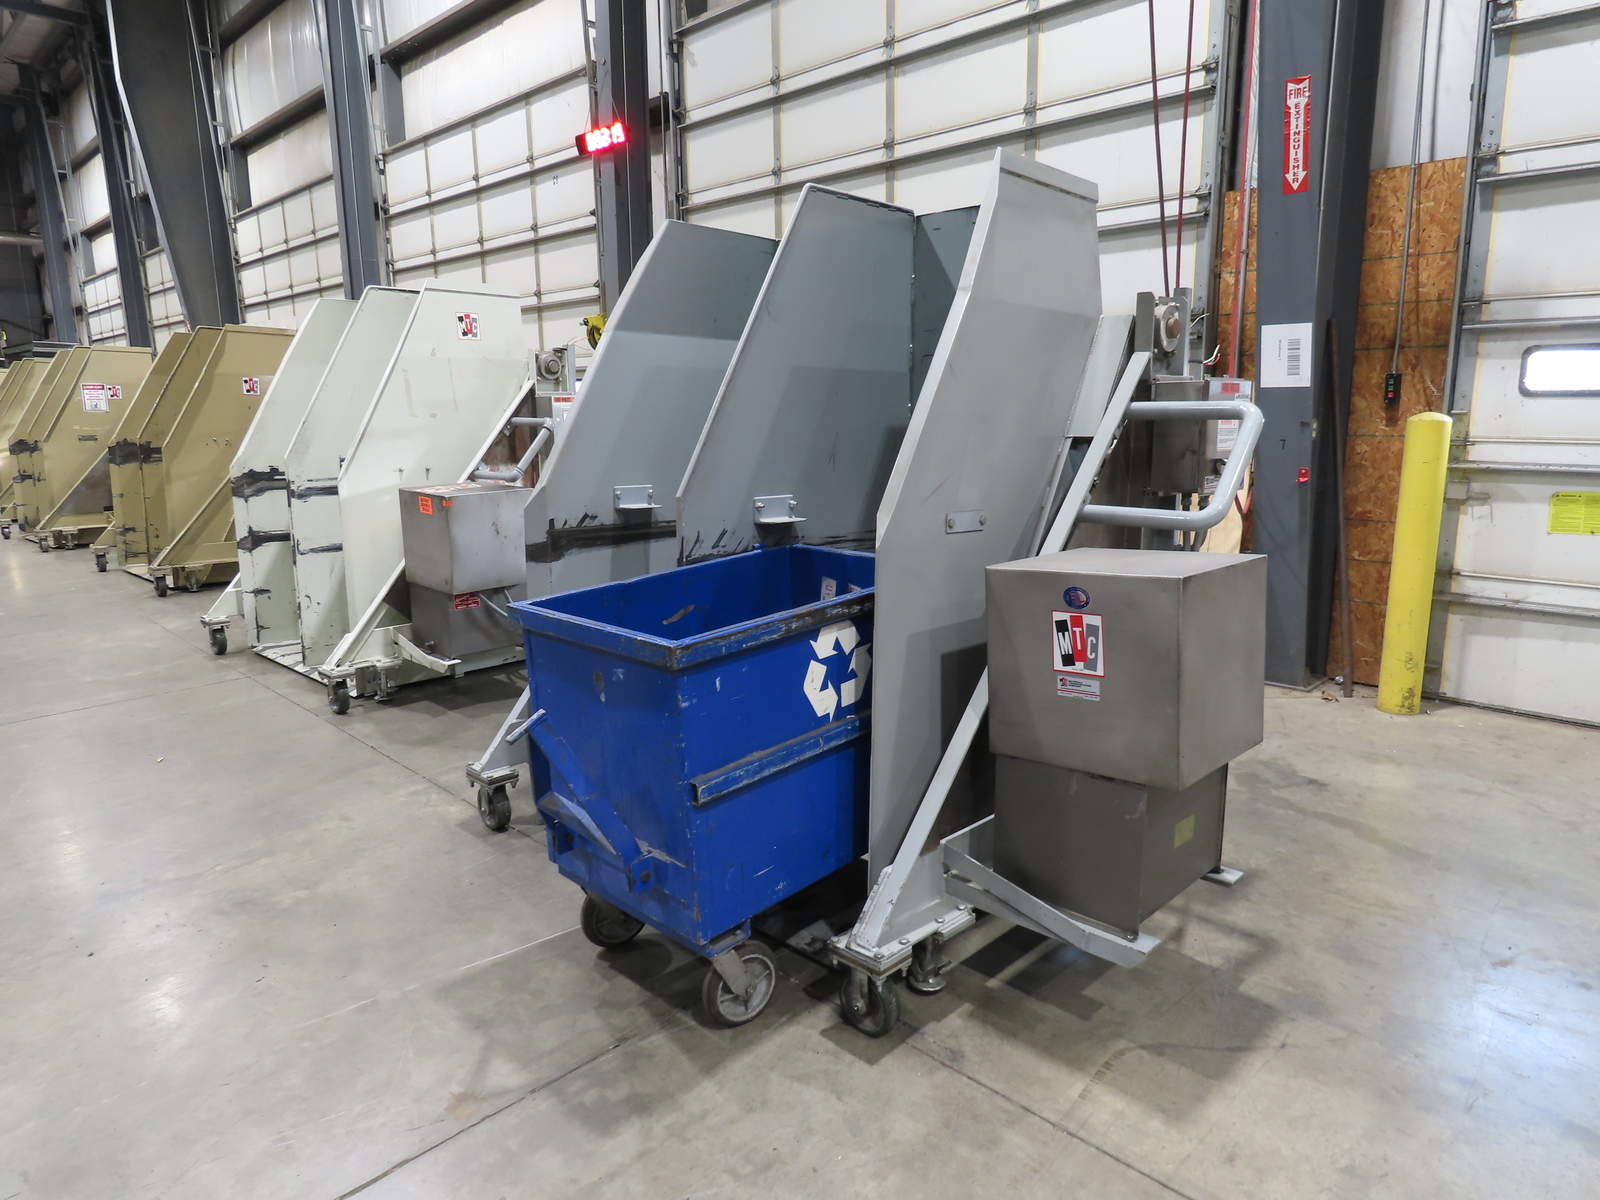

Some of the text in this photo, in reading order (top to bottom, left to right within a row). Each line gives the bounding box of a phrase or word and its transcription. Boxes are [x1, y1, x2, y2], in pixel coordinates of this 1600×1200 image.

[1288, 86, 1308, 100] FIRE
[1292, 102, 1301, 184] EXTINGUISHER
[1279, 438, 1287, 450] 7
[1057, 626, 1097, 660] MTC
